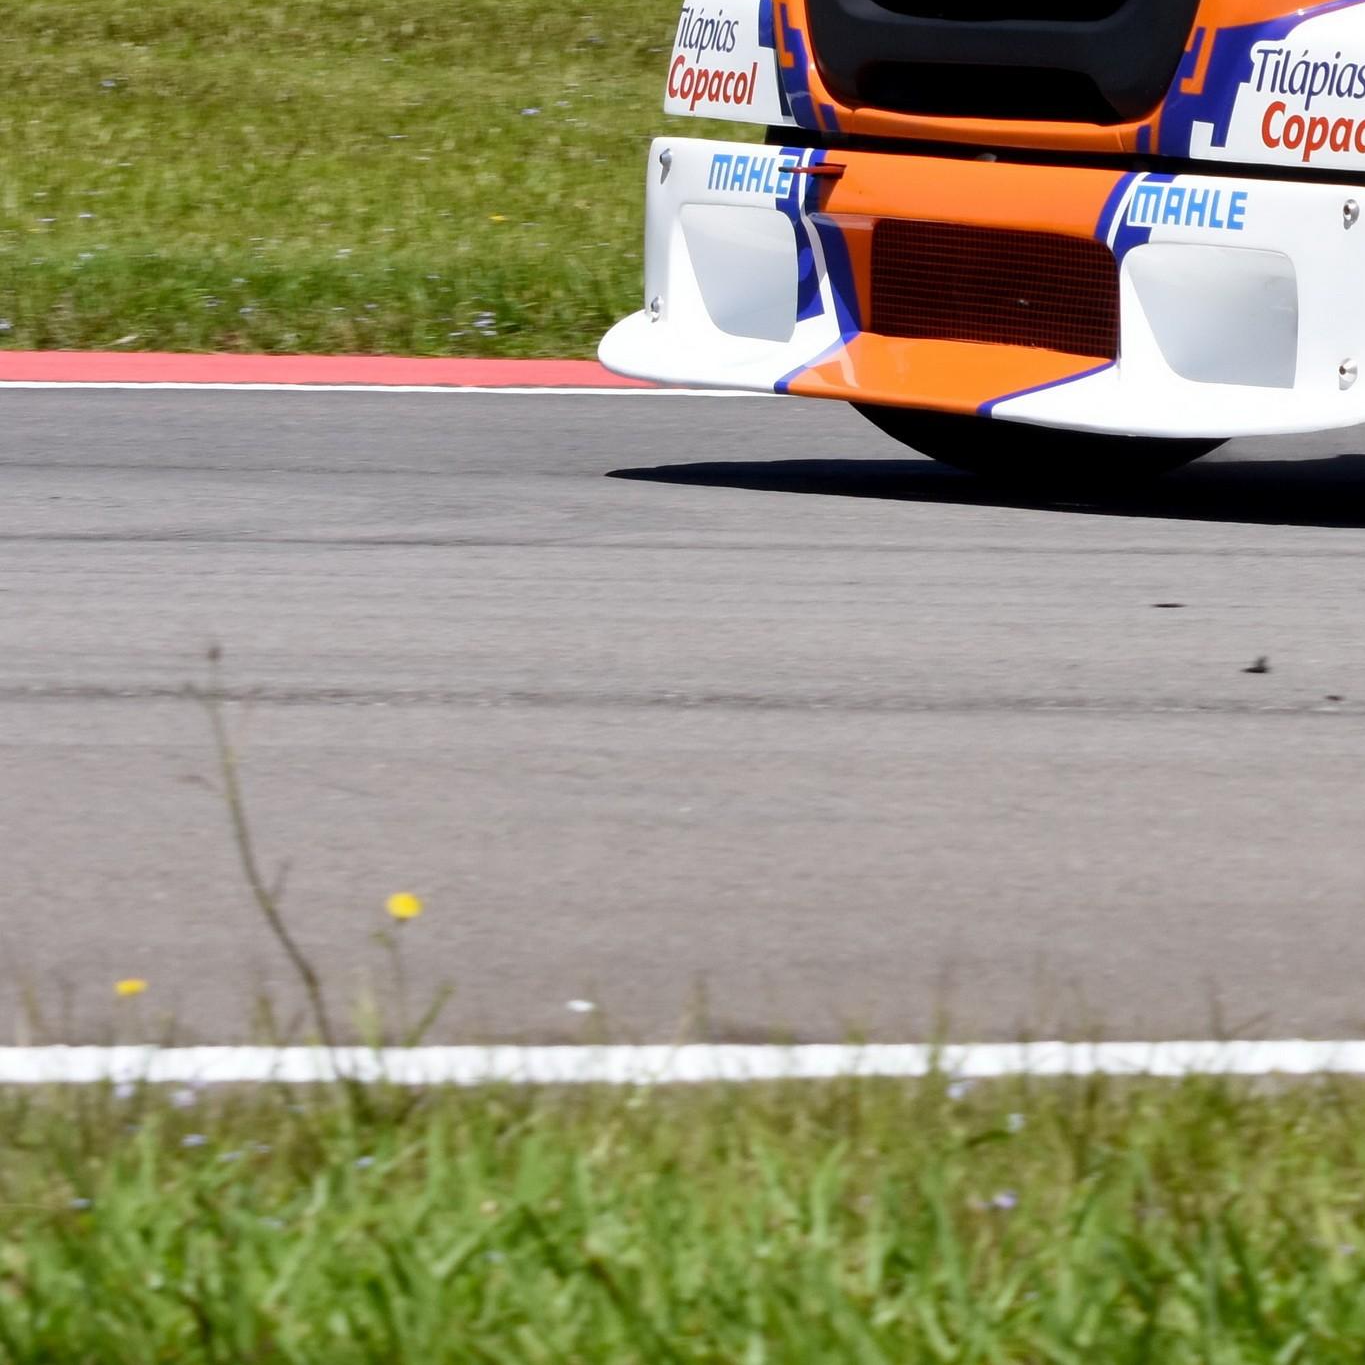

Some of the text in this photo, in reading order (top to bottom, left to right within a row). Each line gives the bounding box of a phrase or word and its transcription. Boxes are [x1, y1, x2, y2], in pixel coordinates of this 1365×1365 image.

[679, 7, 739, 63] Tilápias
[668, 54, 758, 111] Copacol
[708, 154, 797, 196] MAHLE
[1131, 185, 1247, 230] MAHLE
